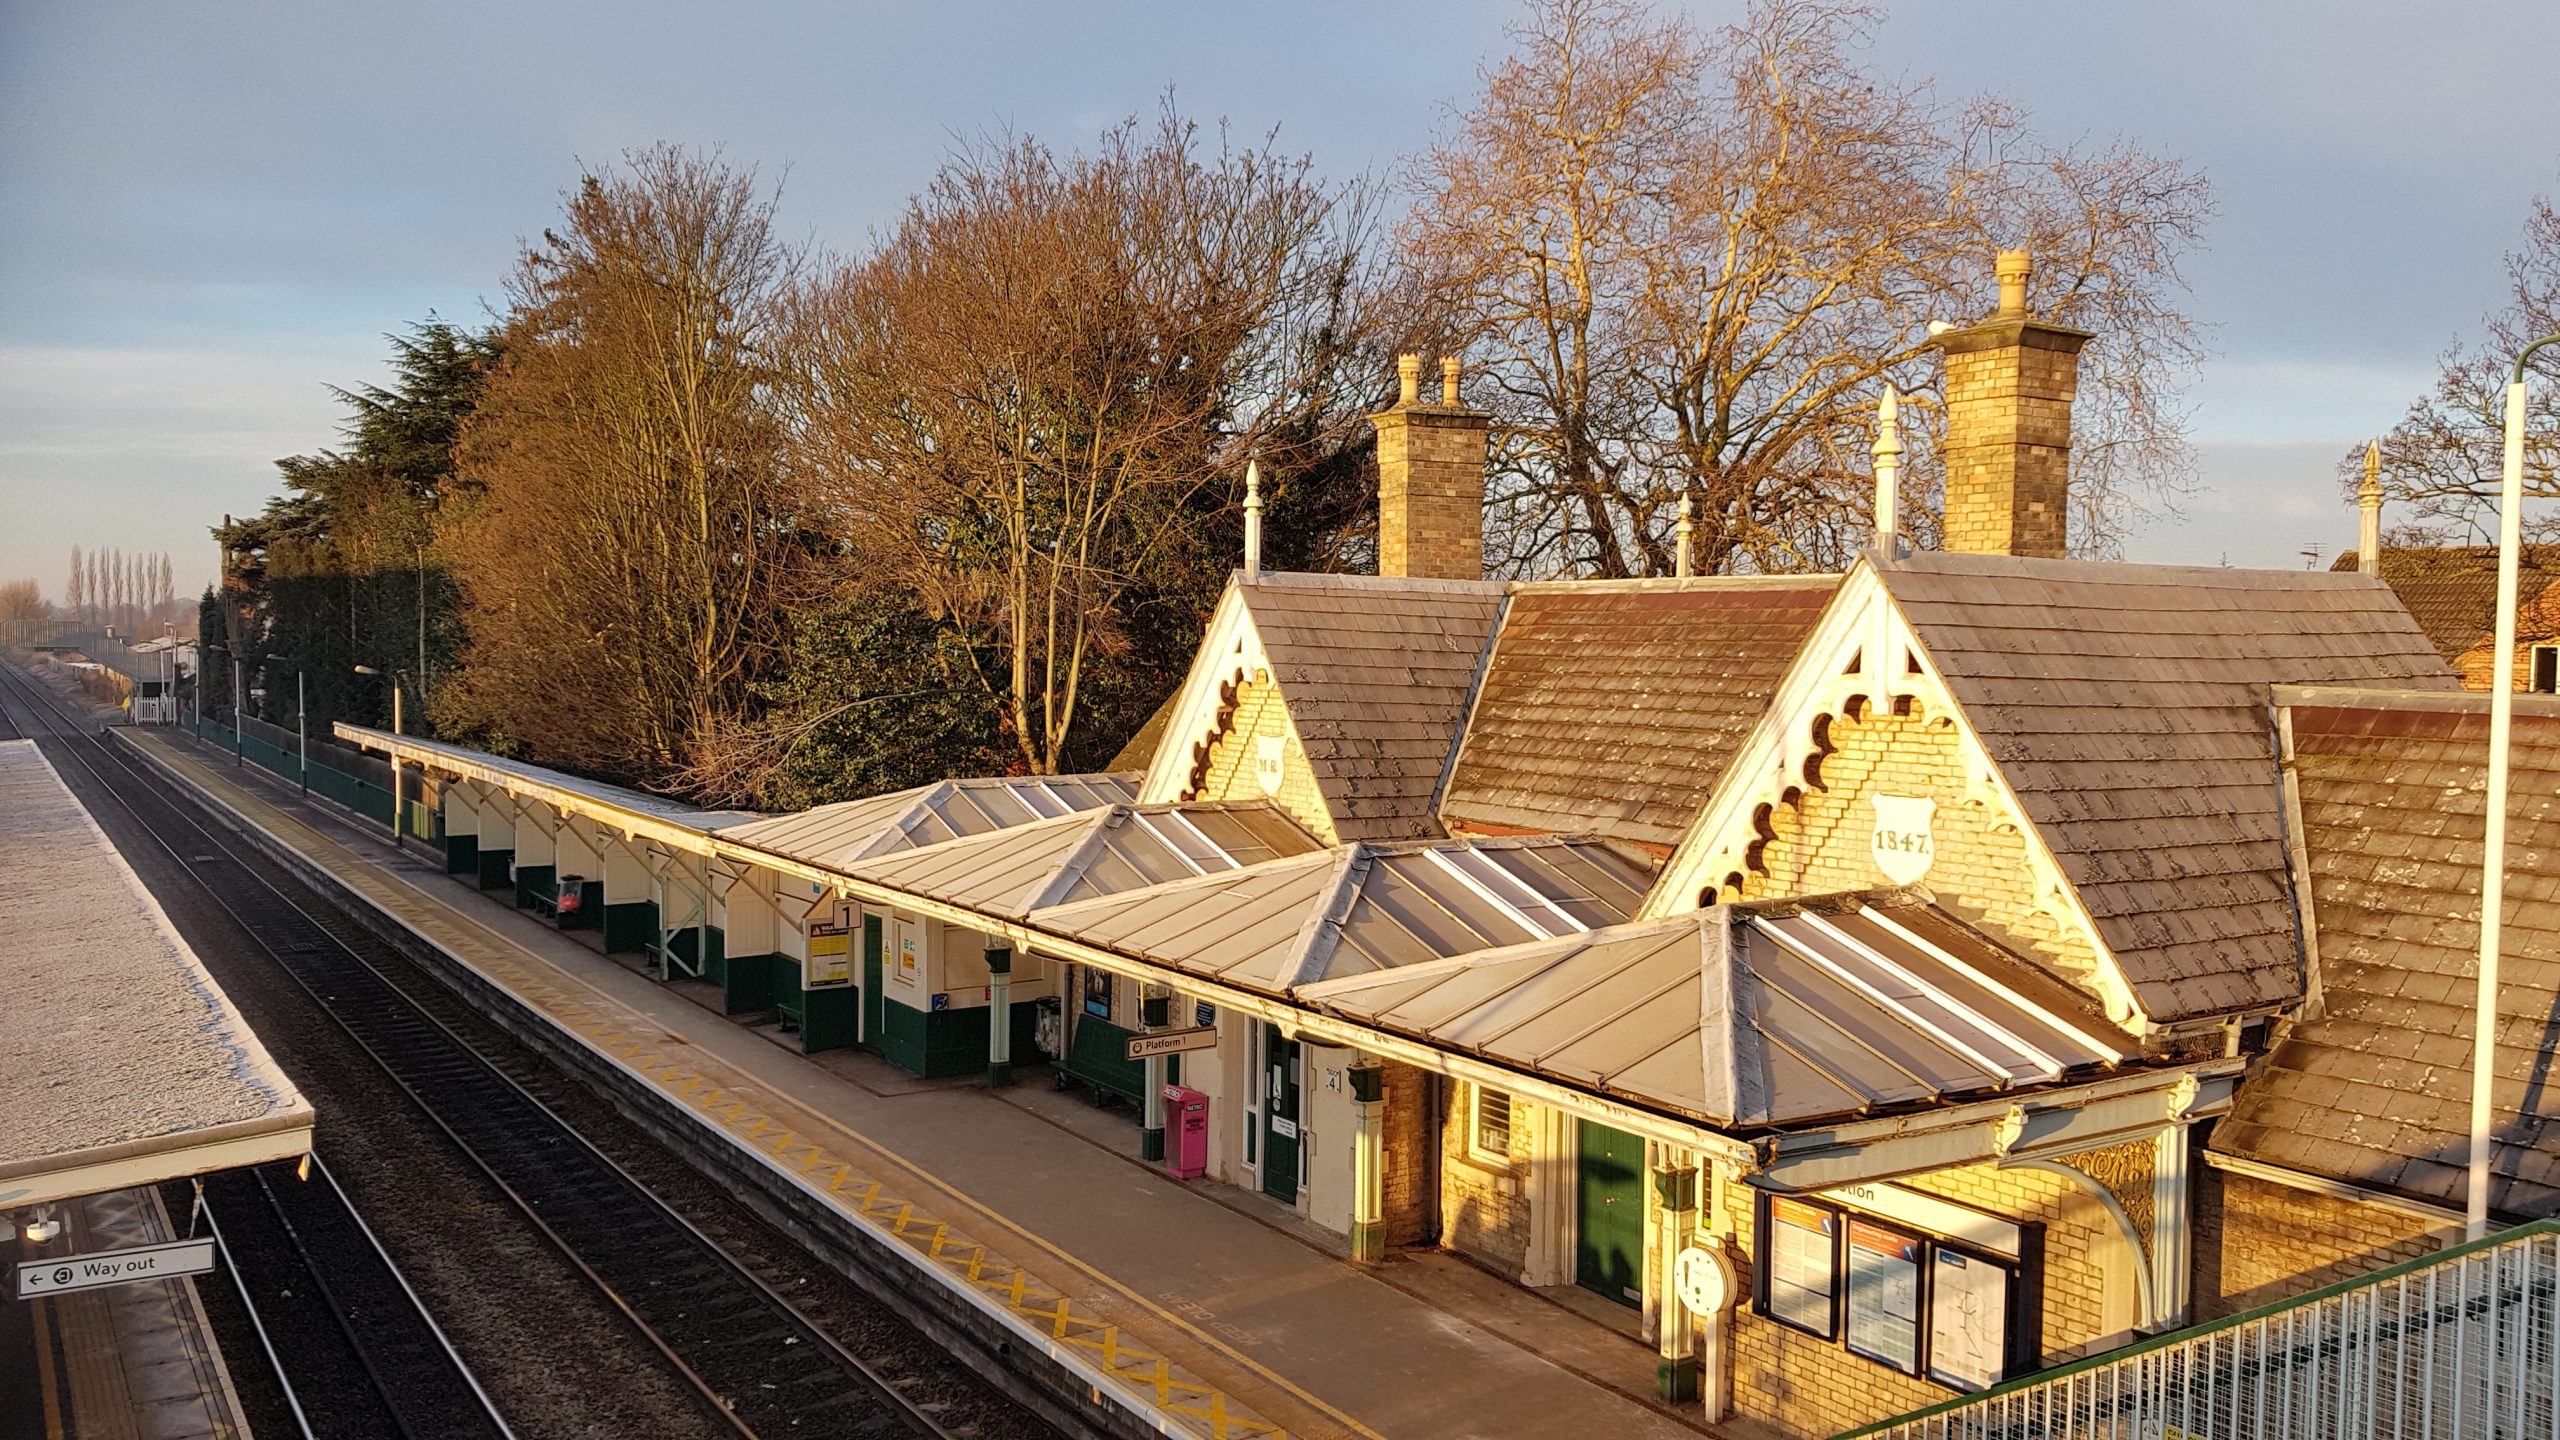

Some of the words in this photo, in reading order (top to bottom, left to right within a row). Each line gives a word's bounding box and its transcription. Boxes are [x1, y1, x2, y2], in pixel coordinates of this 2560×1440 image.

[842, 906, 850, 927] 1
[1146, 1038, 1181, 1050] Platform
[1182, 1036, 1186, 1045] 1
[1329, 1077, 1335, 1090] 4
[84, 1262, 121, 1277] Way
[126, 1257, 155, 1271] out
